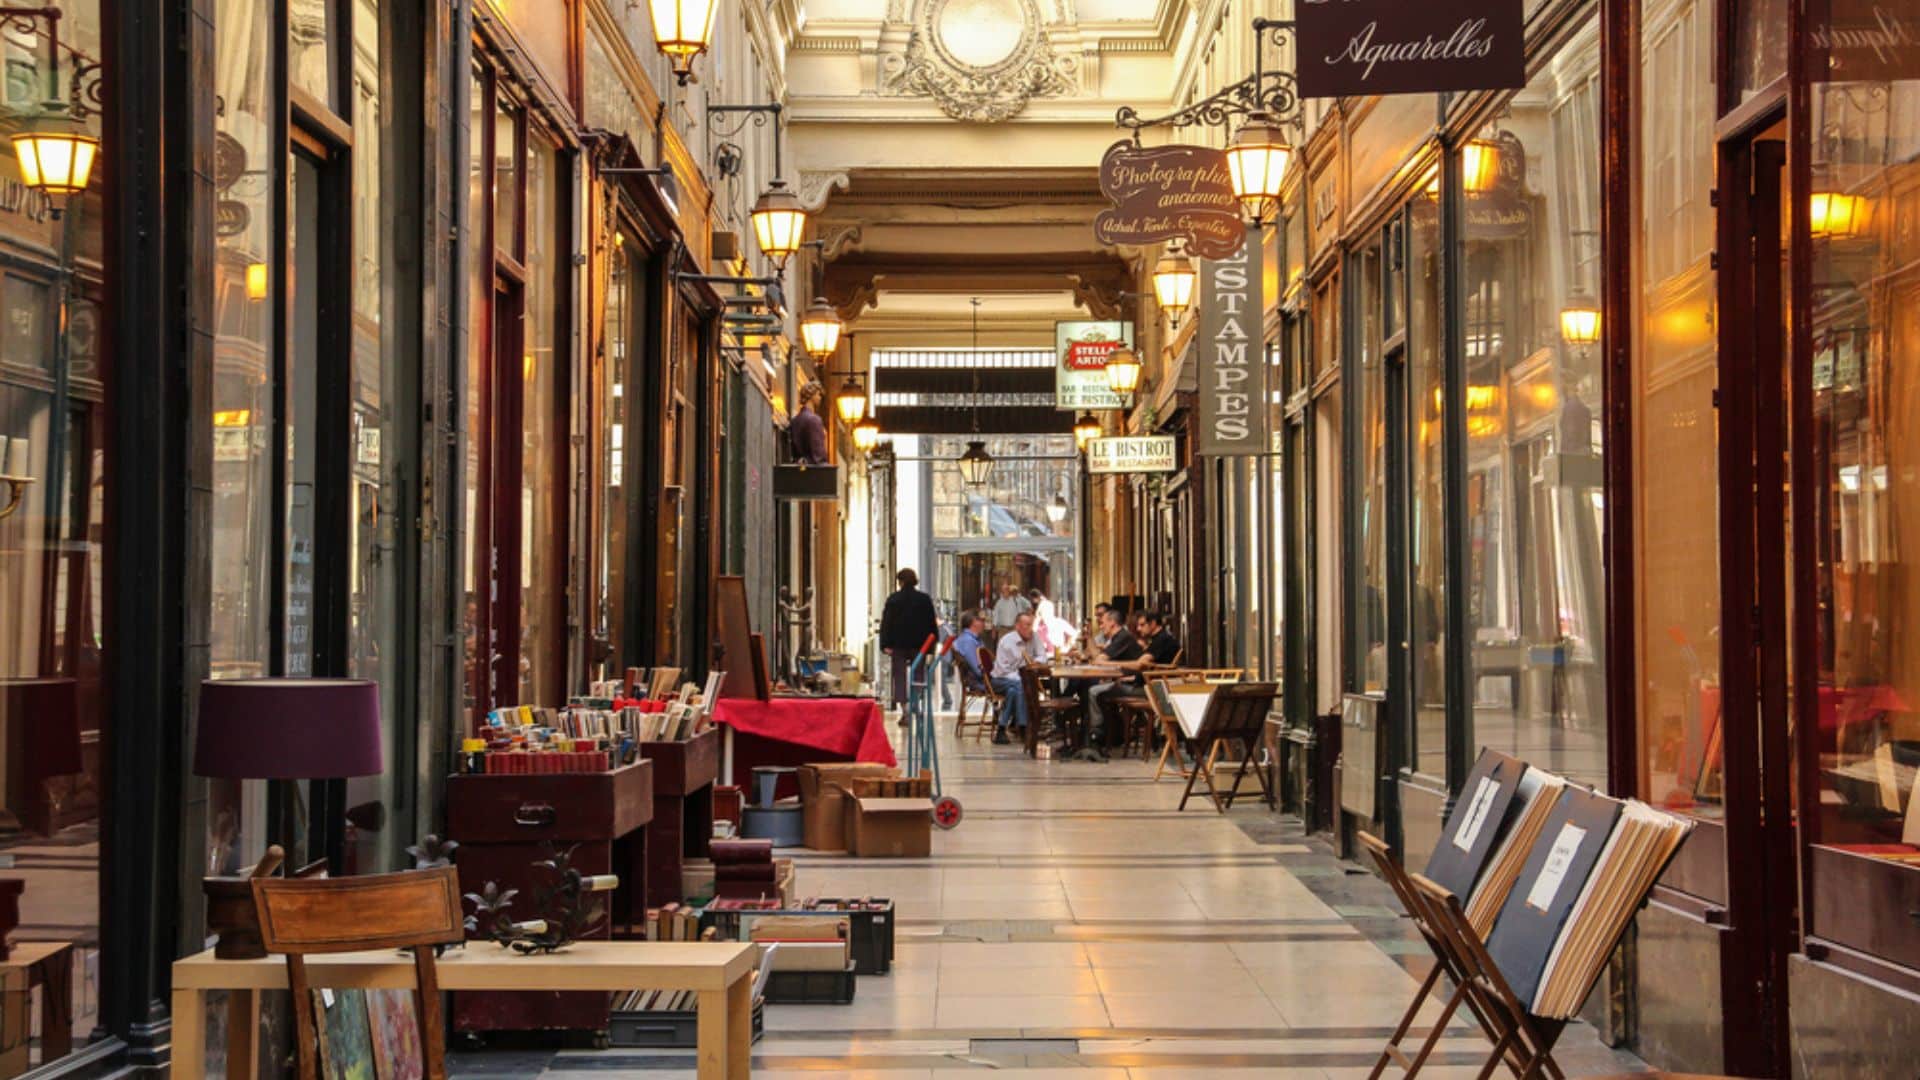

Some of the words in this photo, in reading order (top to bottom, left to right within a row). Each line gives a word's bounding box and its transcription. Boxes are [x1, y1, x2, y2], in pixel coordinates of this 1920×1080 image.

[1324, 17, 1495, 80] Aquarelles
[1075, 345, 1115, 355] STELLA
[1075, 356, 1108, 366] ARTO
[1061, 394, 1075, 405] LE
[1092, 441, 1110, 457] LE
[1116, 439, 1173, 457] BISTROT
[1092, 458, 1110, 468] BAR
[1116, 457, 1173, 468] RESTAURANT
